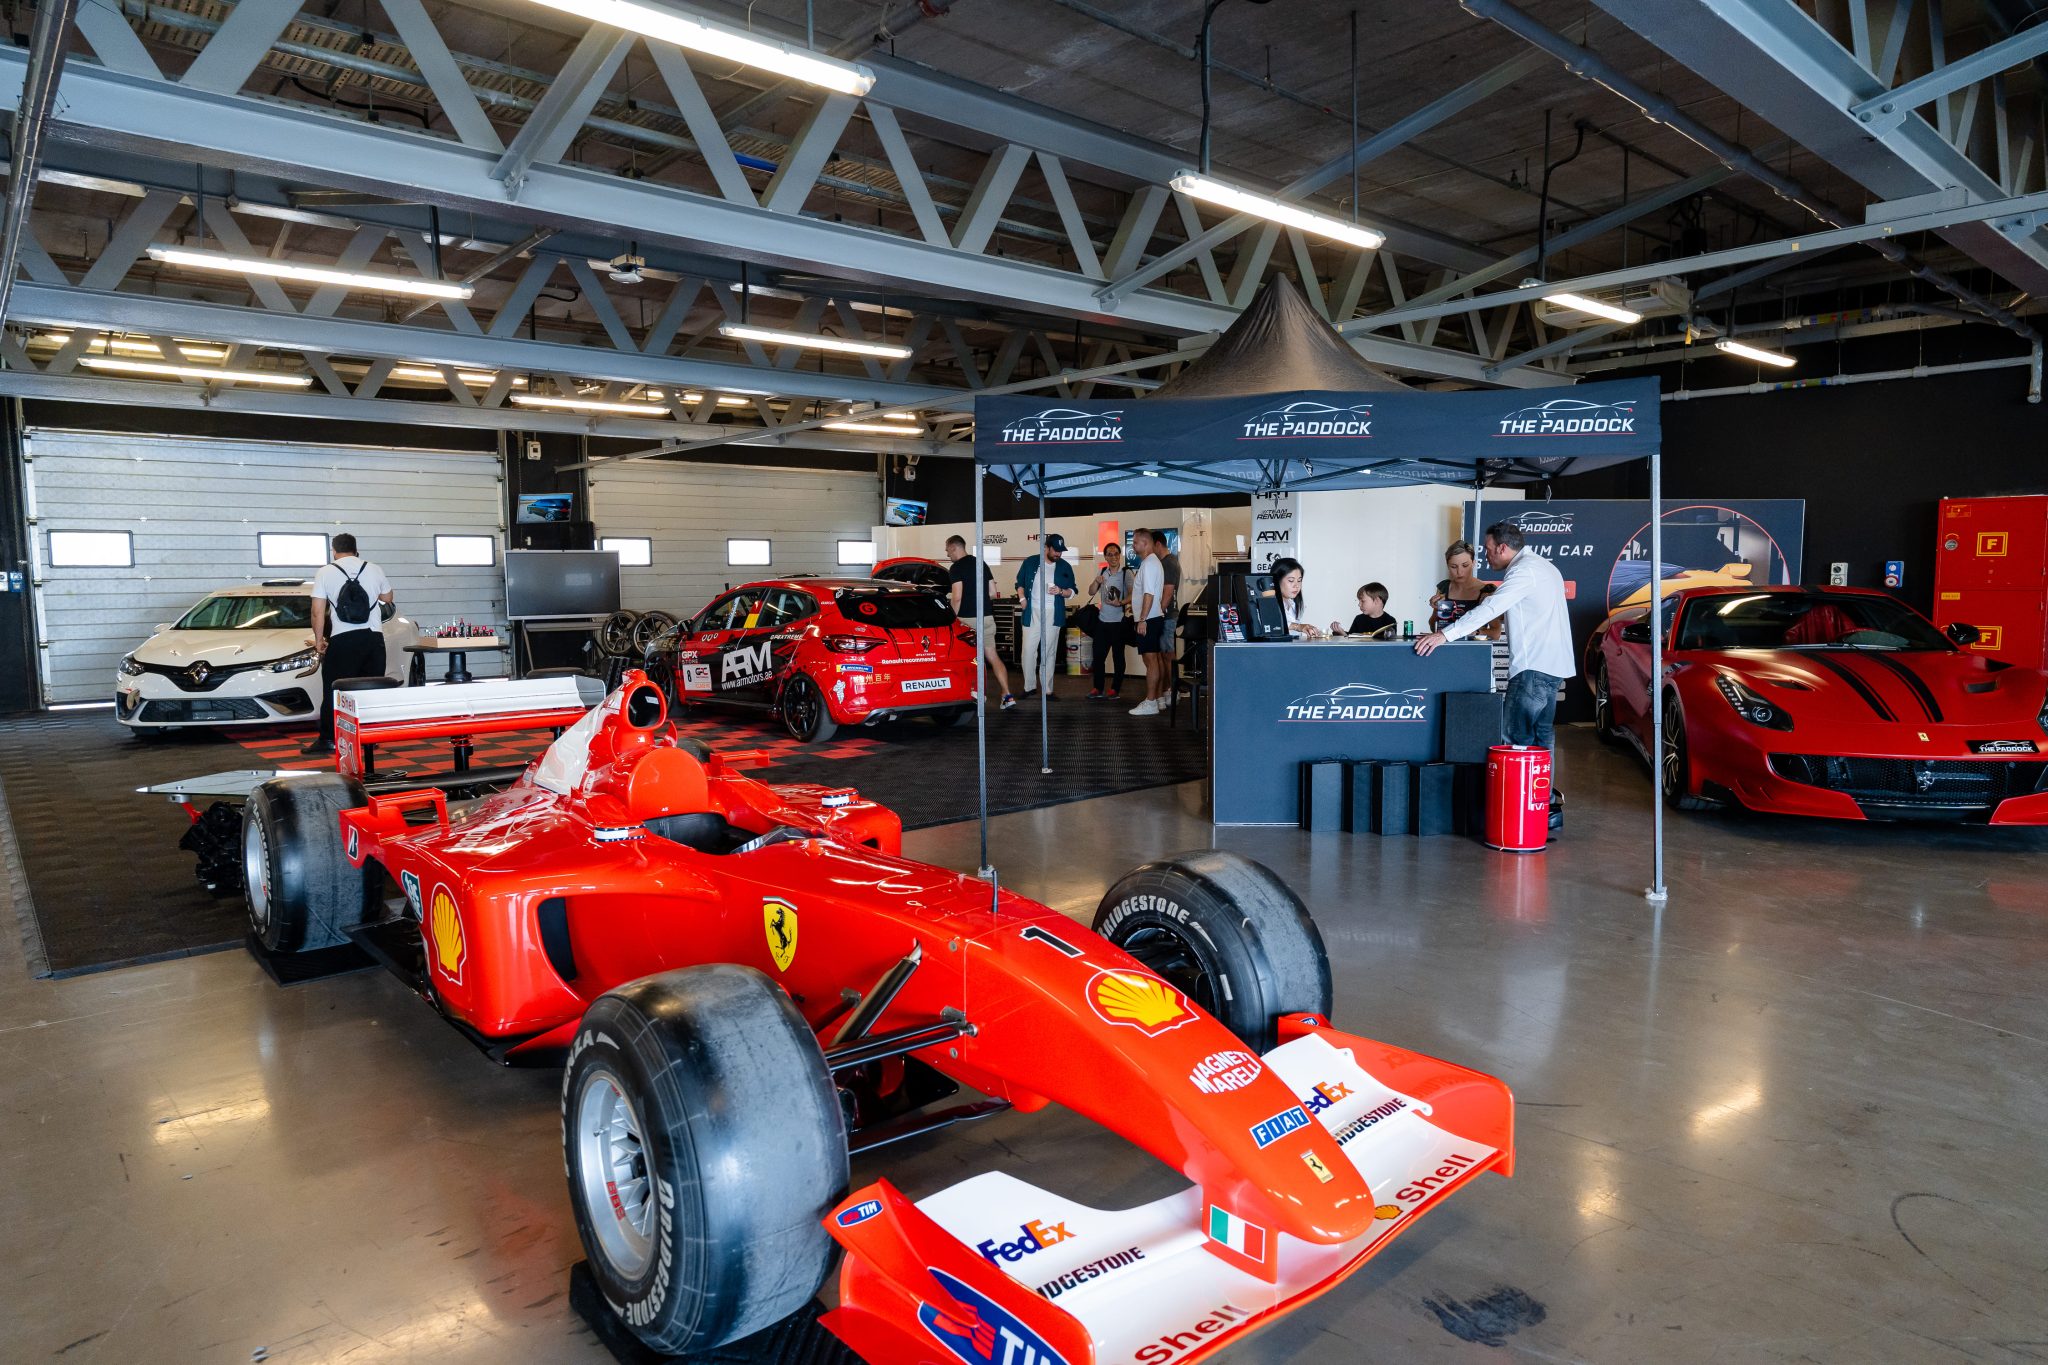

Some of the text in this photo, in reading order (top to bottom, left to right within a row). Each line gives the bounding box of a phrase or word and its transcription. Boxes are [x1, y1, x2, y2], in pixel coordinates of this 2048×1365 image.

[1002, 427, 1123, 442] THE PADDOCK
[1244, 421, 1372, 437] THE PADDOCK
[1500, 418, 1635, 434] THE PADDOCK
[1256, 512, 1293, 520] RENNER
[1256, 530, 1289, 541] ARM
[1520, 523, 1573, 532] PADDOCK
[1559, 545, 1594, 556] CAR
[681, 650, 698, 659] GPX
[721, 641, 772, 682] ARM
[903, 656, 937, 664] recommends
[721, 670, 773, 691] www.armotors.ae
[905, 679, 947, 690] RENAULT
[1286, 705, 1426, 719] THE PADDOCK
[1019, 925, 1086, 959] 1
[1303, 1081, 1355, 1115] edEx
[1255, 1109, 1306, 1143] FIAT
[1336, 1097, 1408, 1147] IDGESTONE
[1395, 1154, 1476, 1203] Shell
[857, 1201, 878, 1218] TIM
[625, 1174, 675, 1327] BRIDGESTONE
[976, 1219, 1077, 1268] FedEx
[1036, 1246, 1146, 1299] IDGESTONE
[1134, 1304, 1250, 1365] Shell
